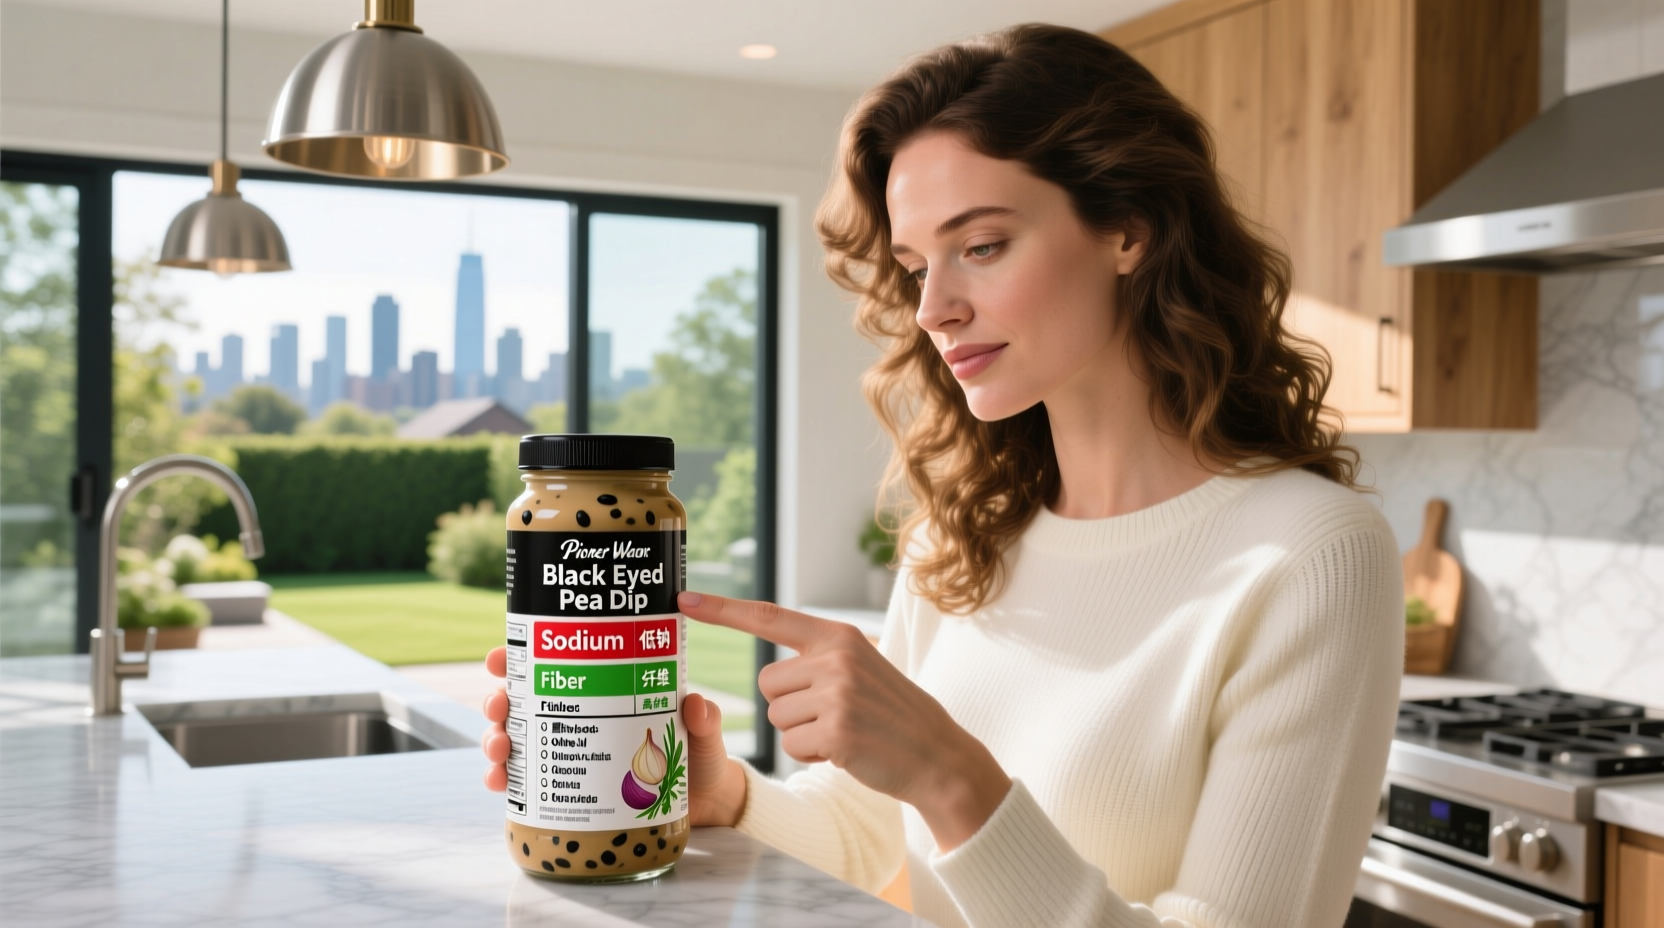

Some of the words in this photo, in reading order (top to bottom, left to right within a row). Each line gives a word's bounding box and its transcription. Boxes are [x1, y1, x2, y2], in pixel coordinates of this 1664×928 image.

[543, 563, 606, 586] Black
[613, 562, 664, 589] Eyed
[560, 589, 603, 610] Pea
[610, 589, 648, 614] Dip
[541, 629, 624, 651] Sodium
[541, 670, 587, 690] Fiber
